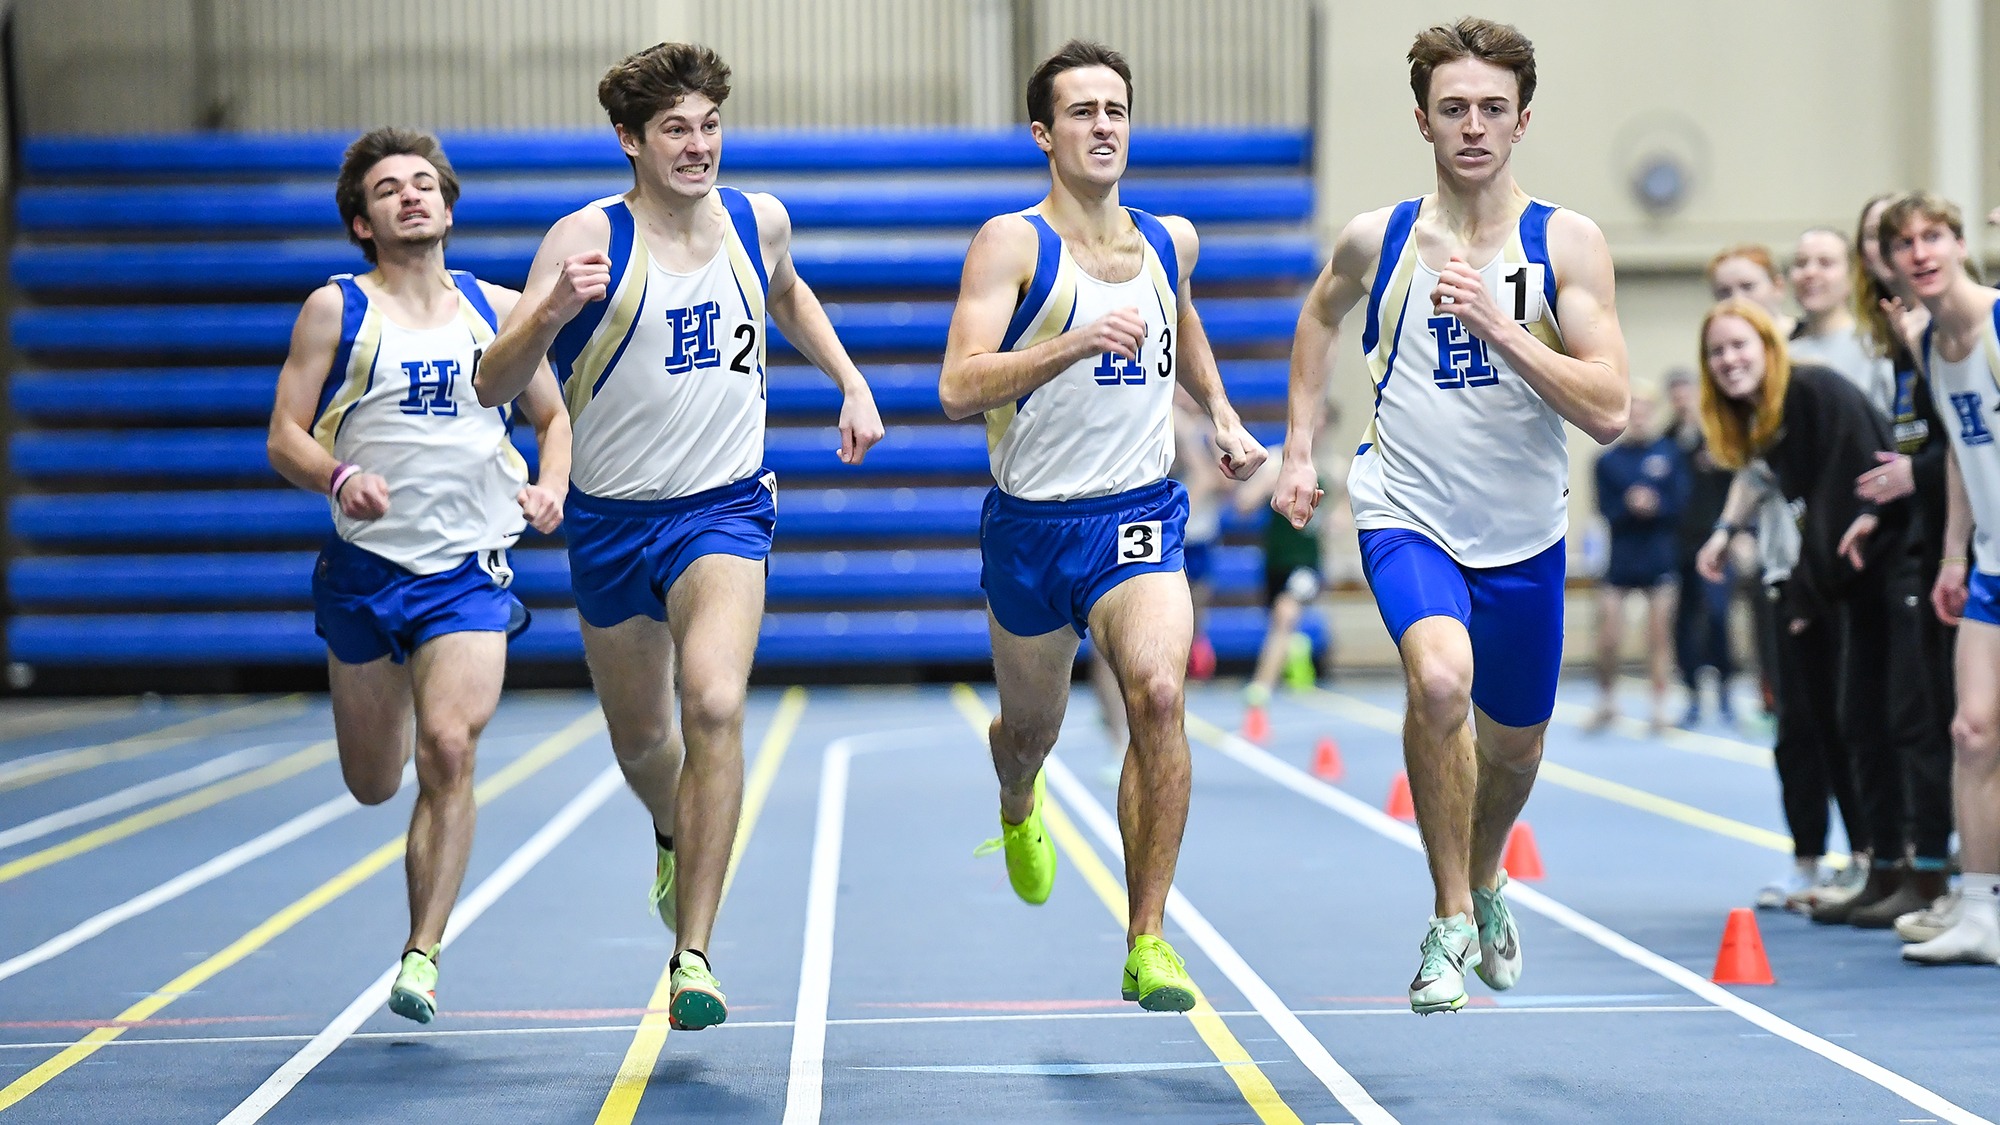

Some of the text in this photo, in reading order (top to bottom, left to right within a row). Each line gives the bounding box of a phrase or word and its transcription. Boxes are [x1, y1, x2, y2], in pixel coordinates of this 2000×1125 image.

[1505, 268, 1527, 320] 1
[665, 301, 720, 375] H
[730, 324, 755, 374] 2
[1158, 327, 1172, 378] 3
[1427, 316, 1499, 389] H
[399, 360, 460, 416] H
[1123, 525, 1153, 558] 3
